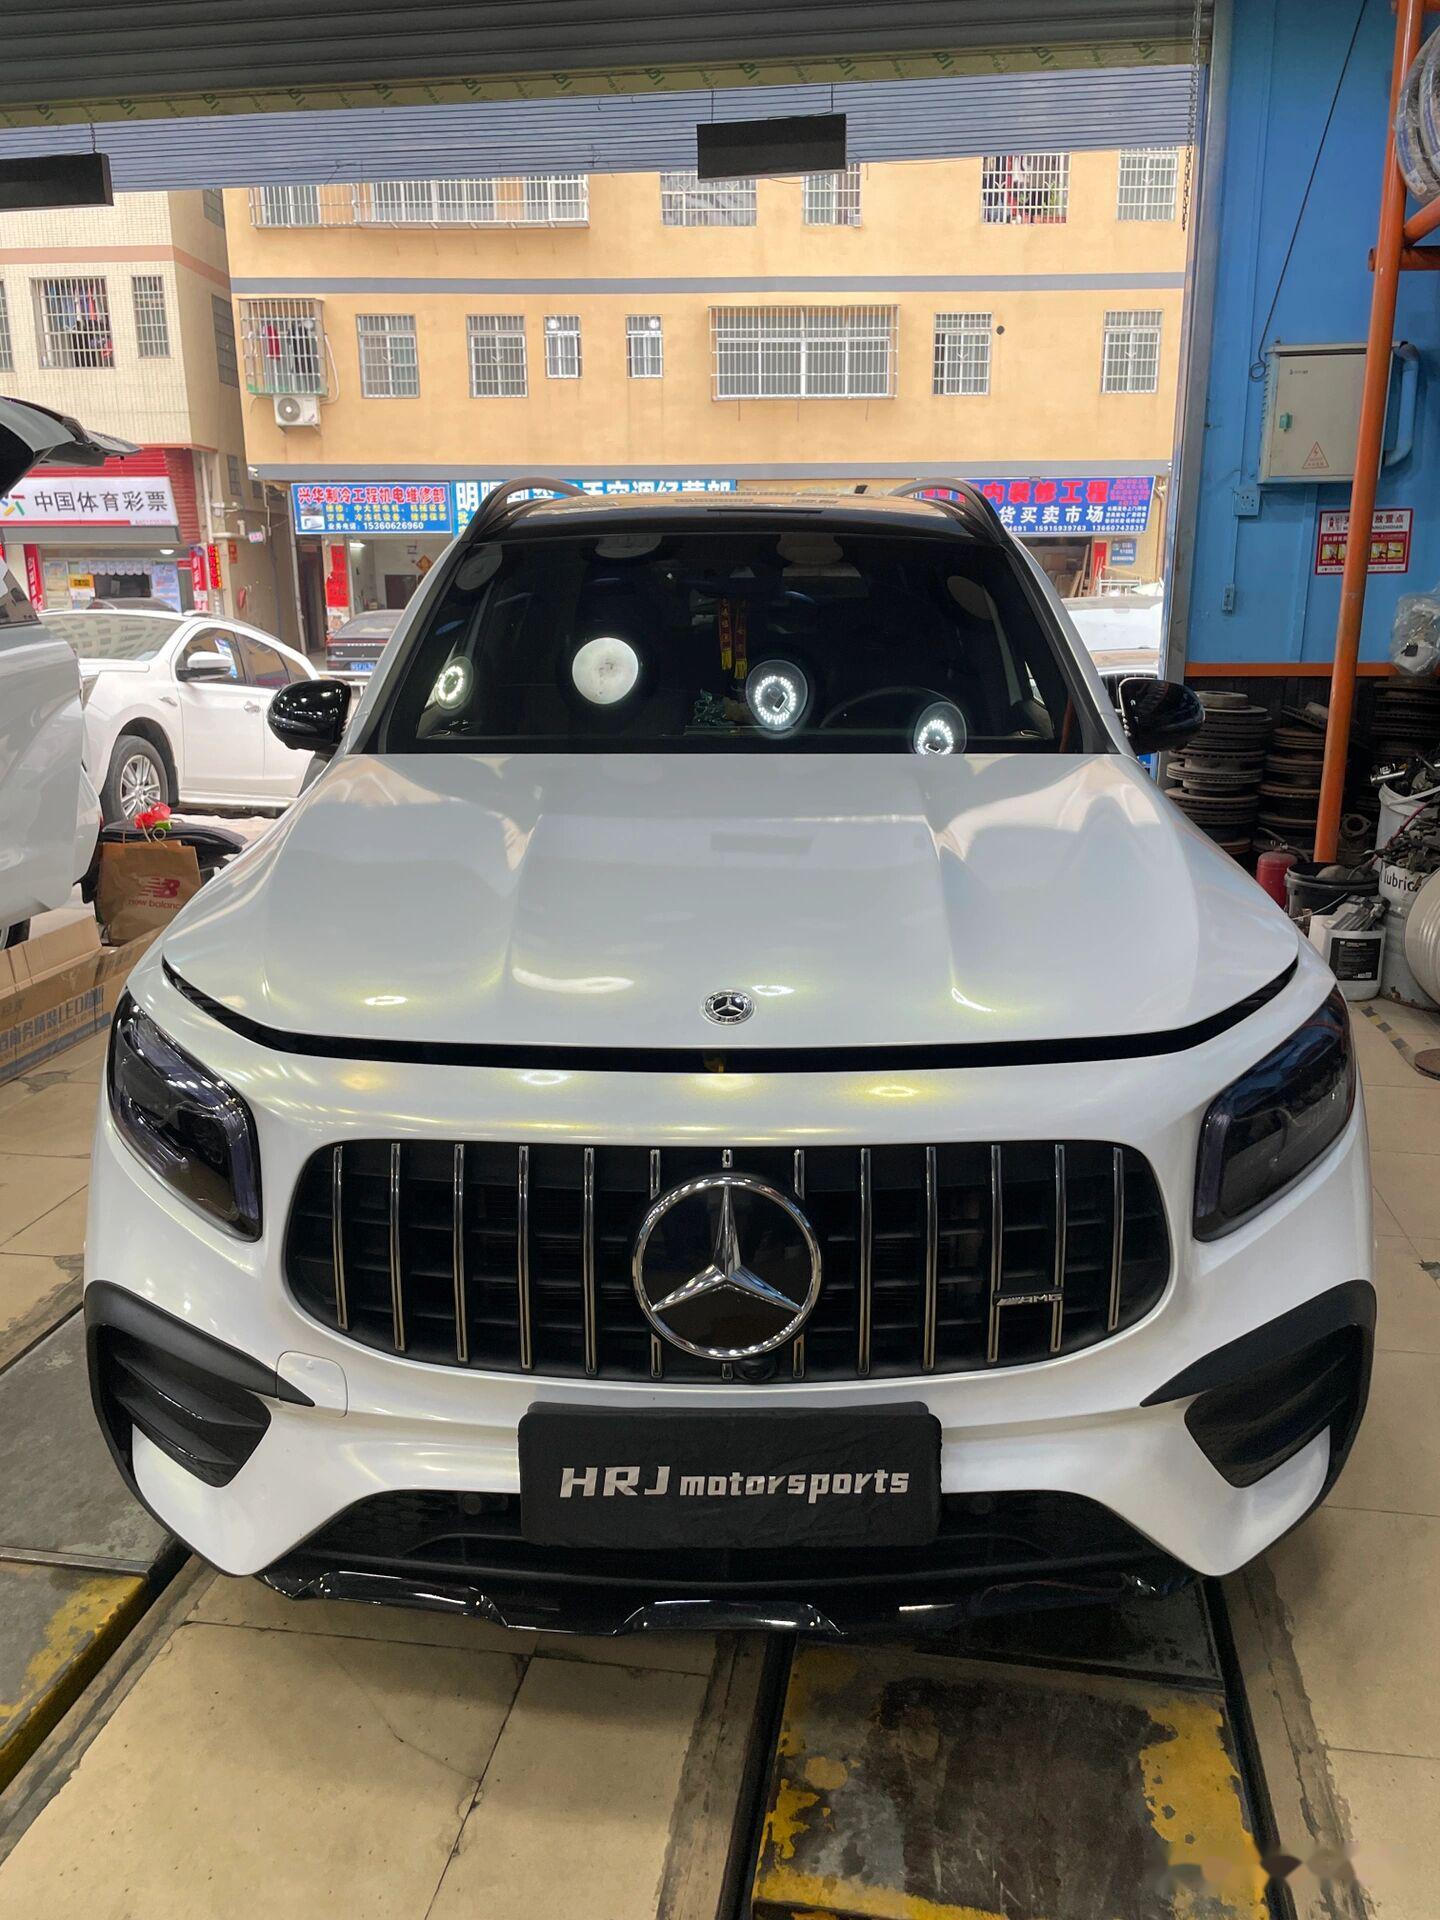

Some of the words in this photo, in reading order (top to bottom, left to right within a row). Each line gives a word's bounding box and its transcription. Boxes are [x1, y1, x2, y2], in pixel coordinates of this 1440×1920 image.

[34, 491, 168, 513] 中国体育彩票
[298, 486, 446, 504] 兴华制冷工程机电维修部
[1384, 871, 1420, 893] lubric
[149, 899, 181, 910] balanc
[559, 1466, 671, 1498] HRJ
[679, 1469, 910, 1504] motorsports
